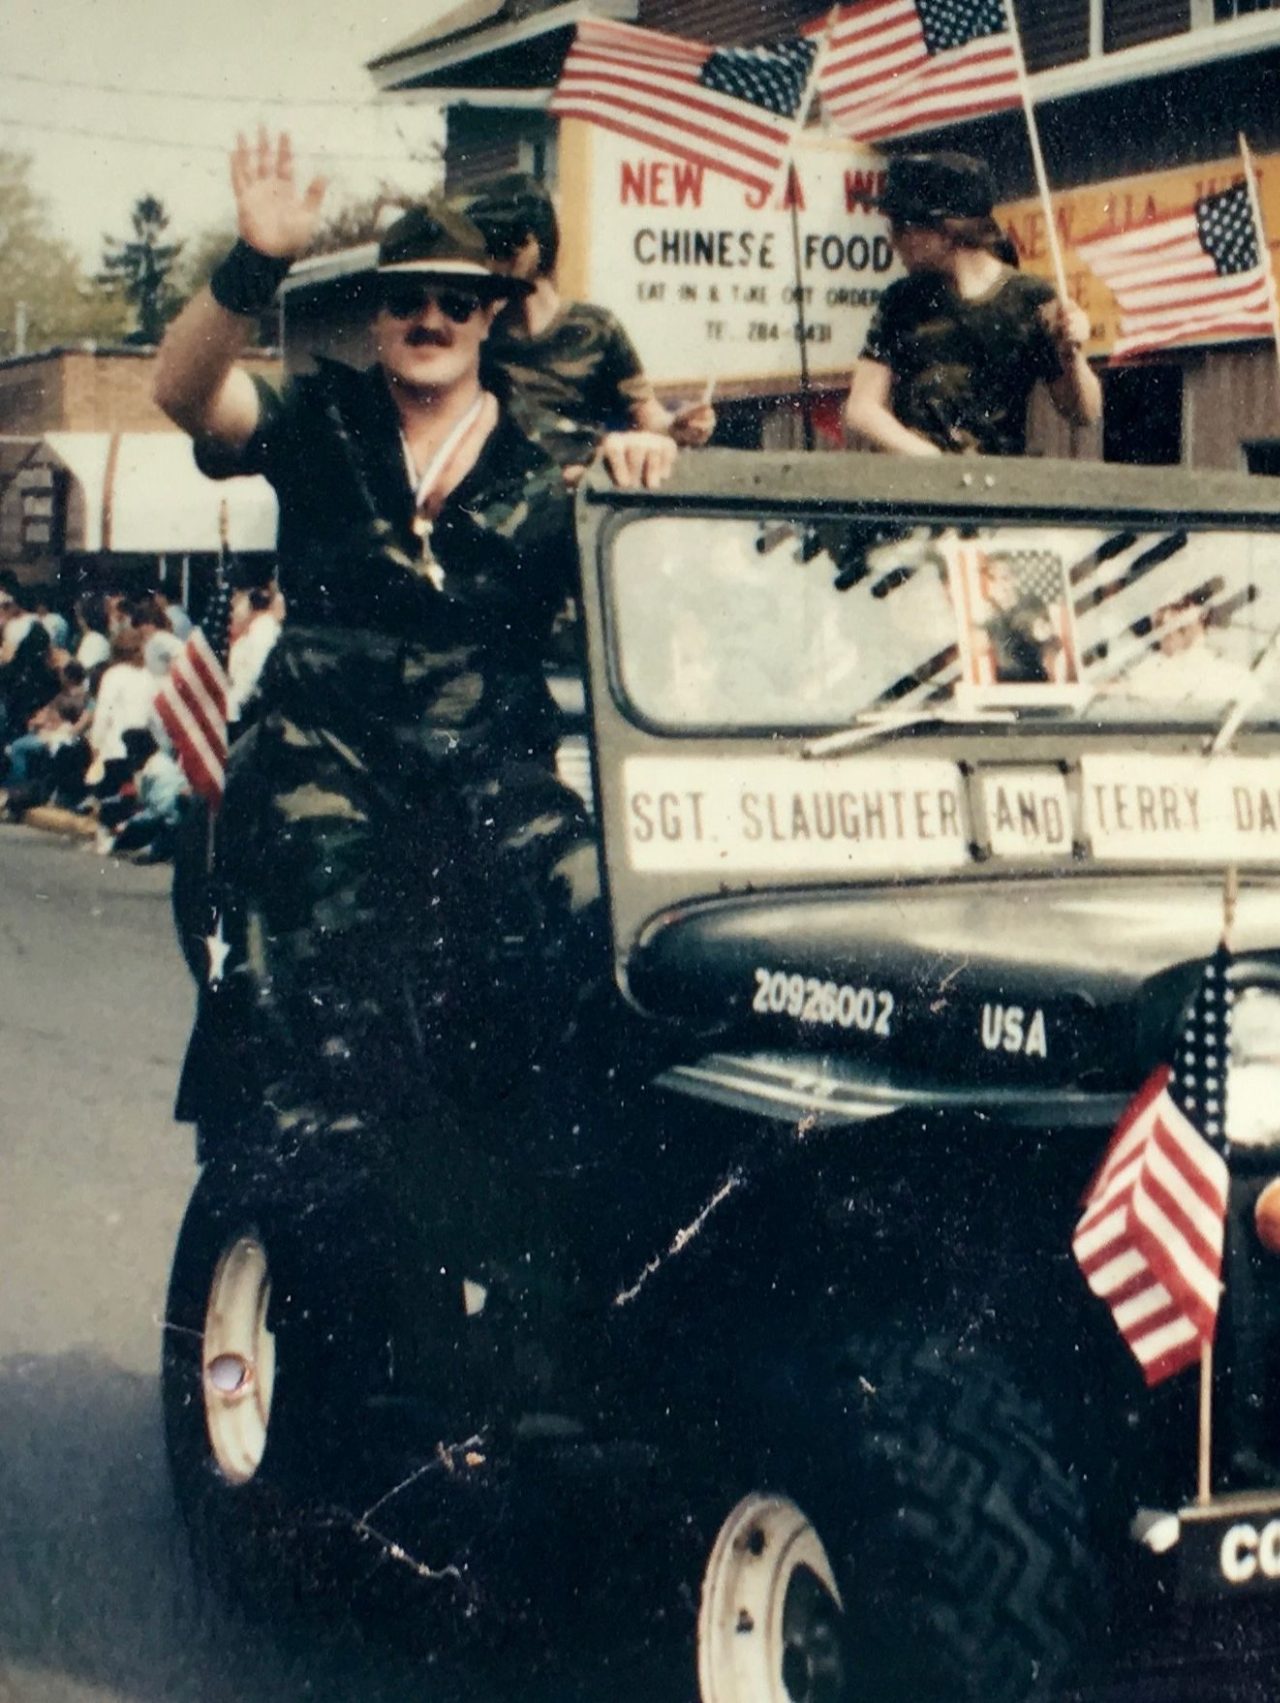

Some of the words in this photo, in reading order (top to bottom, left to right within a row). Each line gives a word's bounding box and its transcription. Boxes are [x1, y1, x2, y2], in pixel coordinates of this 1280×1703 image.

[619, 160, 704, 206] NEW
[633, 228, 775, 269] CHINESE
[805, 234, 893, 272] FOOD
[740, 788, 959, 842] SLAUGHTER
[995, 783, 1064, 845] AND
[1091, 782, 1200, 834] TERRY
[752, 967, 894, 1037] 20926002
[980, 1002, 1047, 1059] USA
